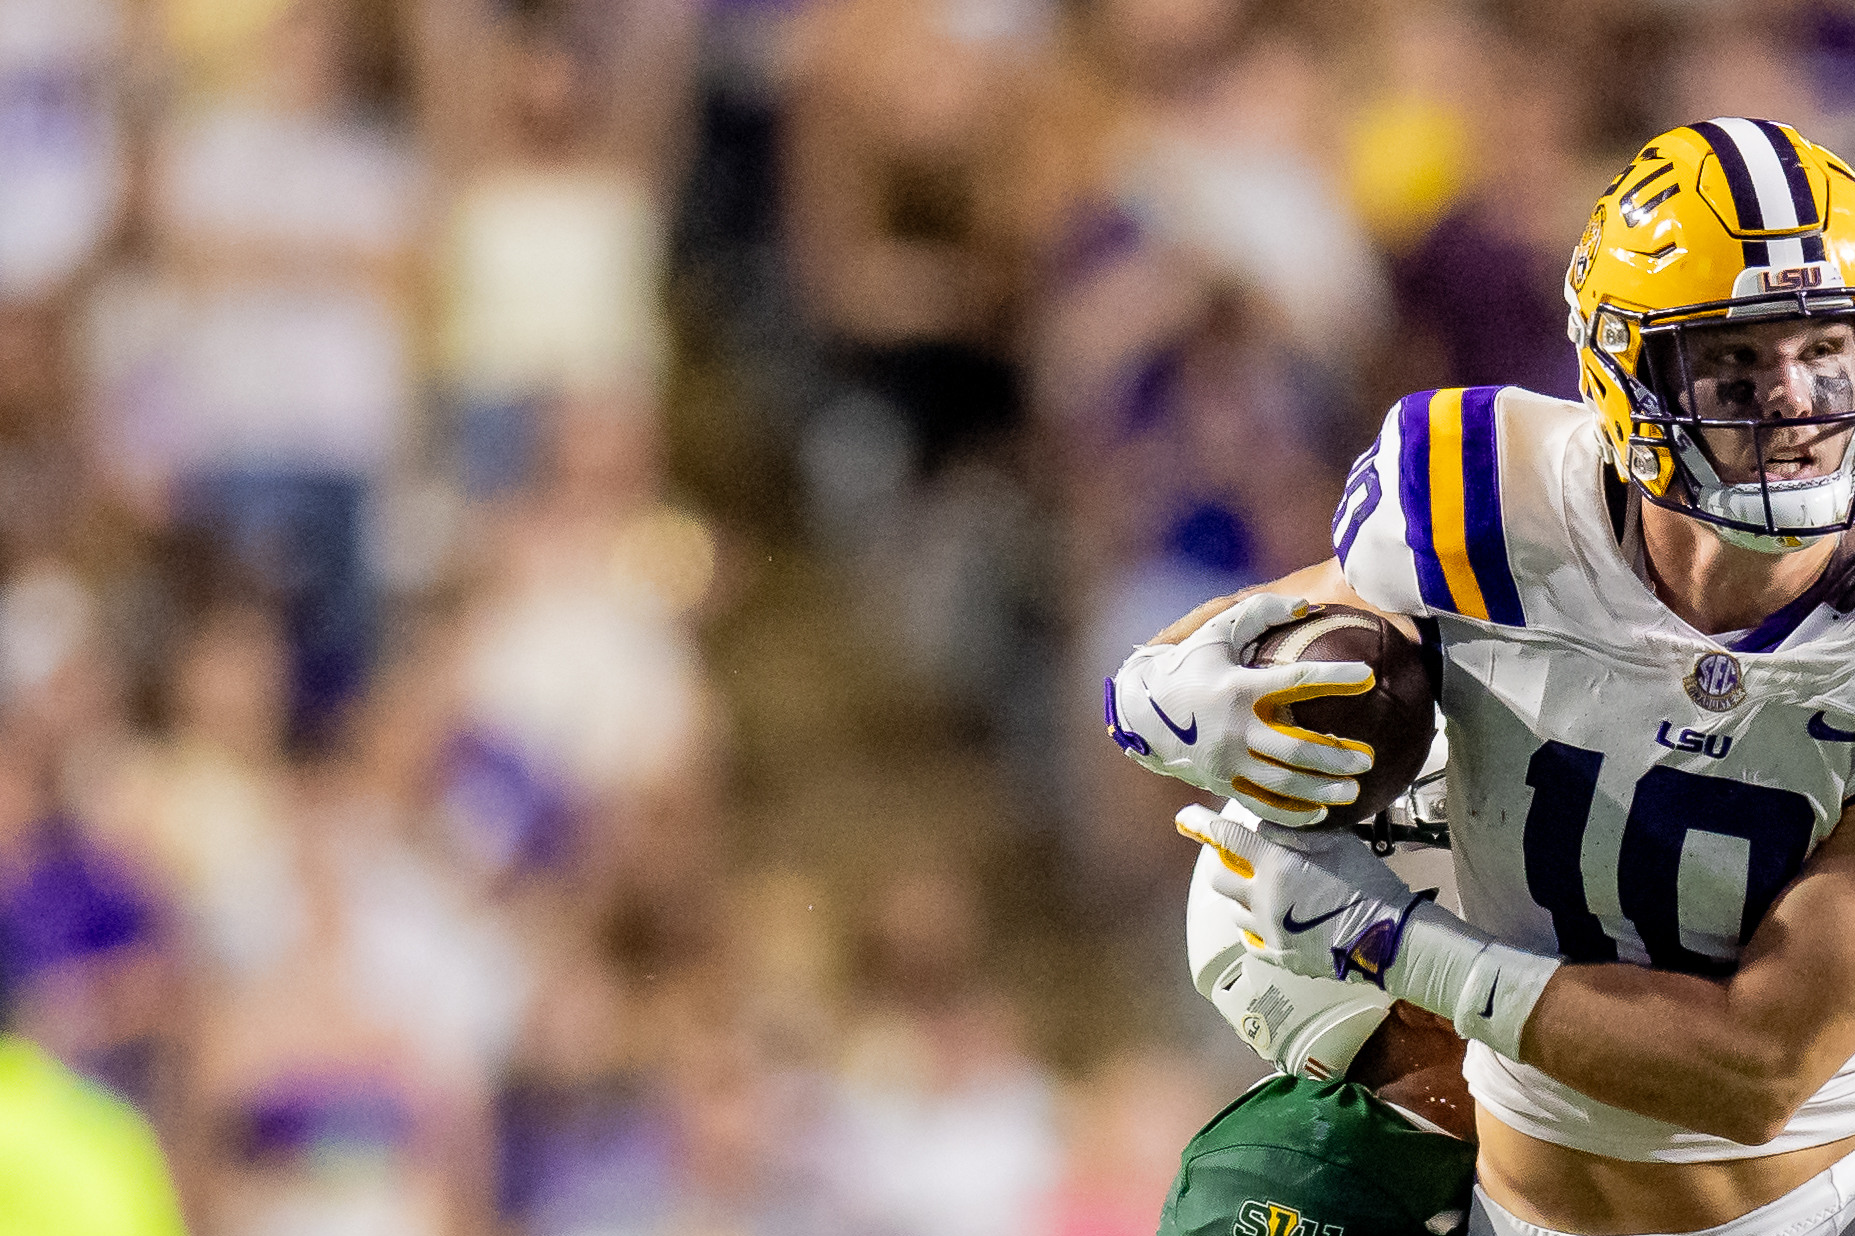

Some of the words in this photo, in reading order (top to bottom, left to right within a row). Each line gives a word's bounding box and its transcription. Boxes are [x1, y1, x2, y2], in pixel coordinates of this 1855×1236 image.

[1762, 267, 1822, 293] LSU
[1698, 655, 1736, 696] SEC
[1656, 720, 1734, 760] LSU
[1524, 740, 1817, 977] 10
